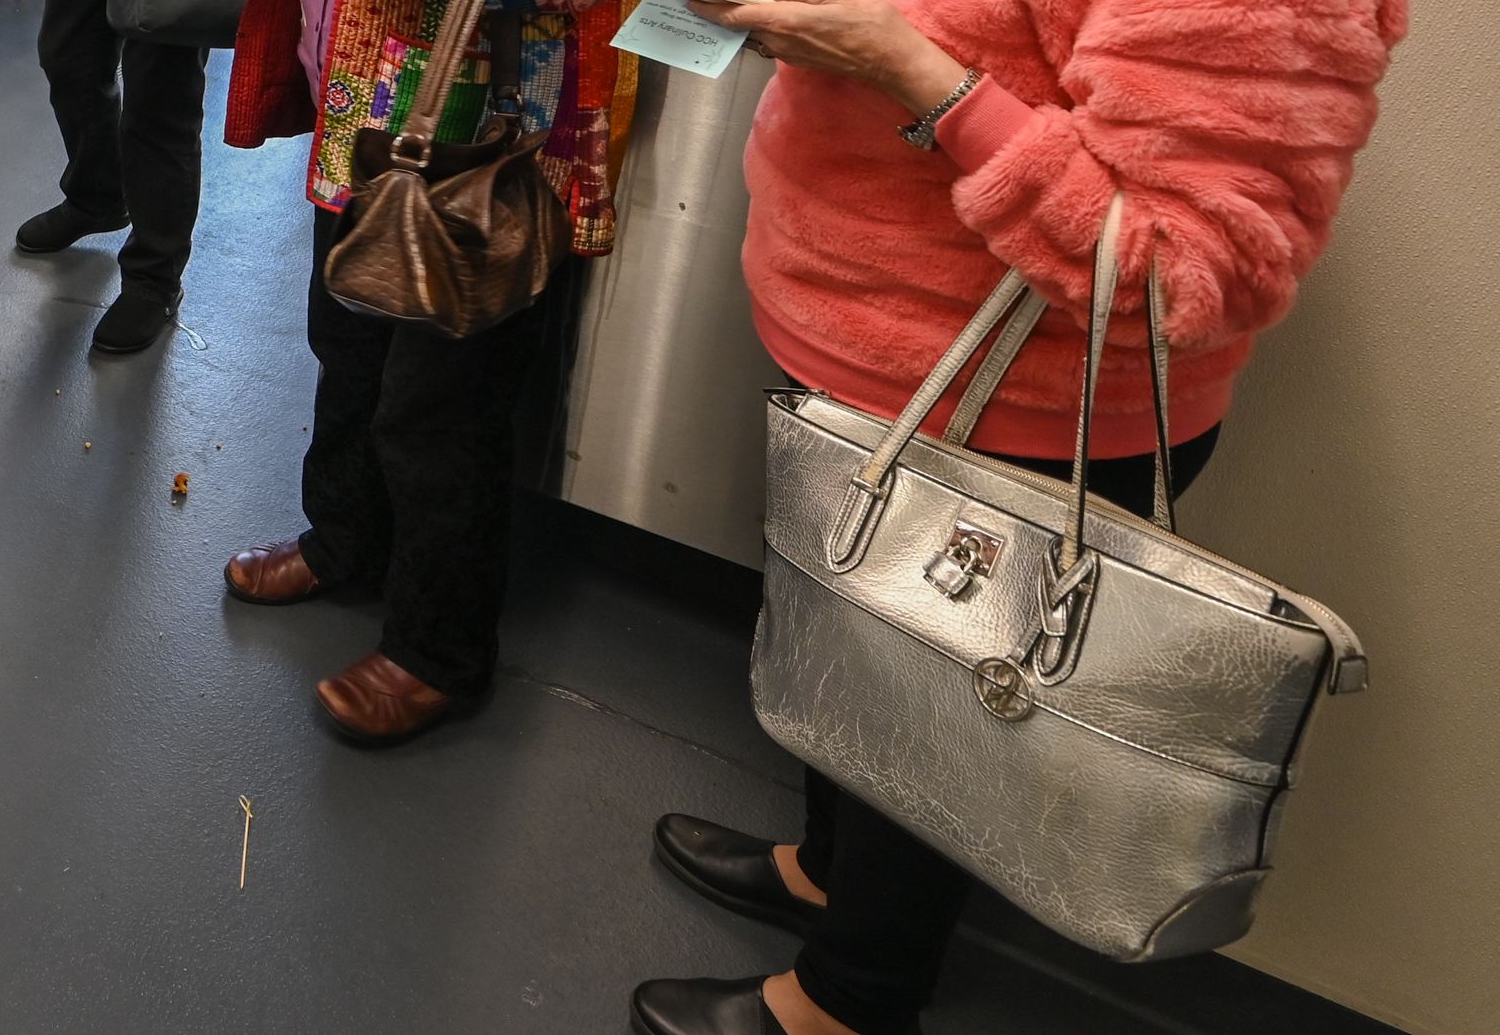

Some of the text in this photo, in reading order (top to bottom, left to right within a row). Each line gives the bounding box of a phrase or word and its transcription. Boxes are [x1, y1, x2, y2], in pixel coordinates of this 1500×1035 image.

[639, 17, 719, 47] HCC Culinary Arts
